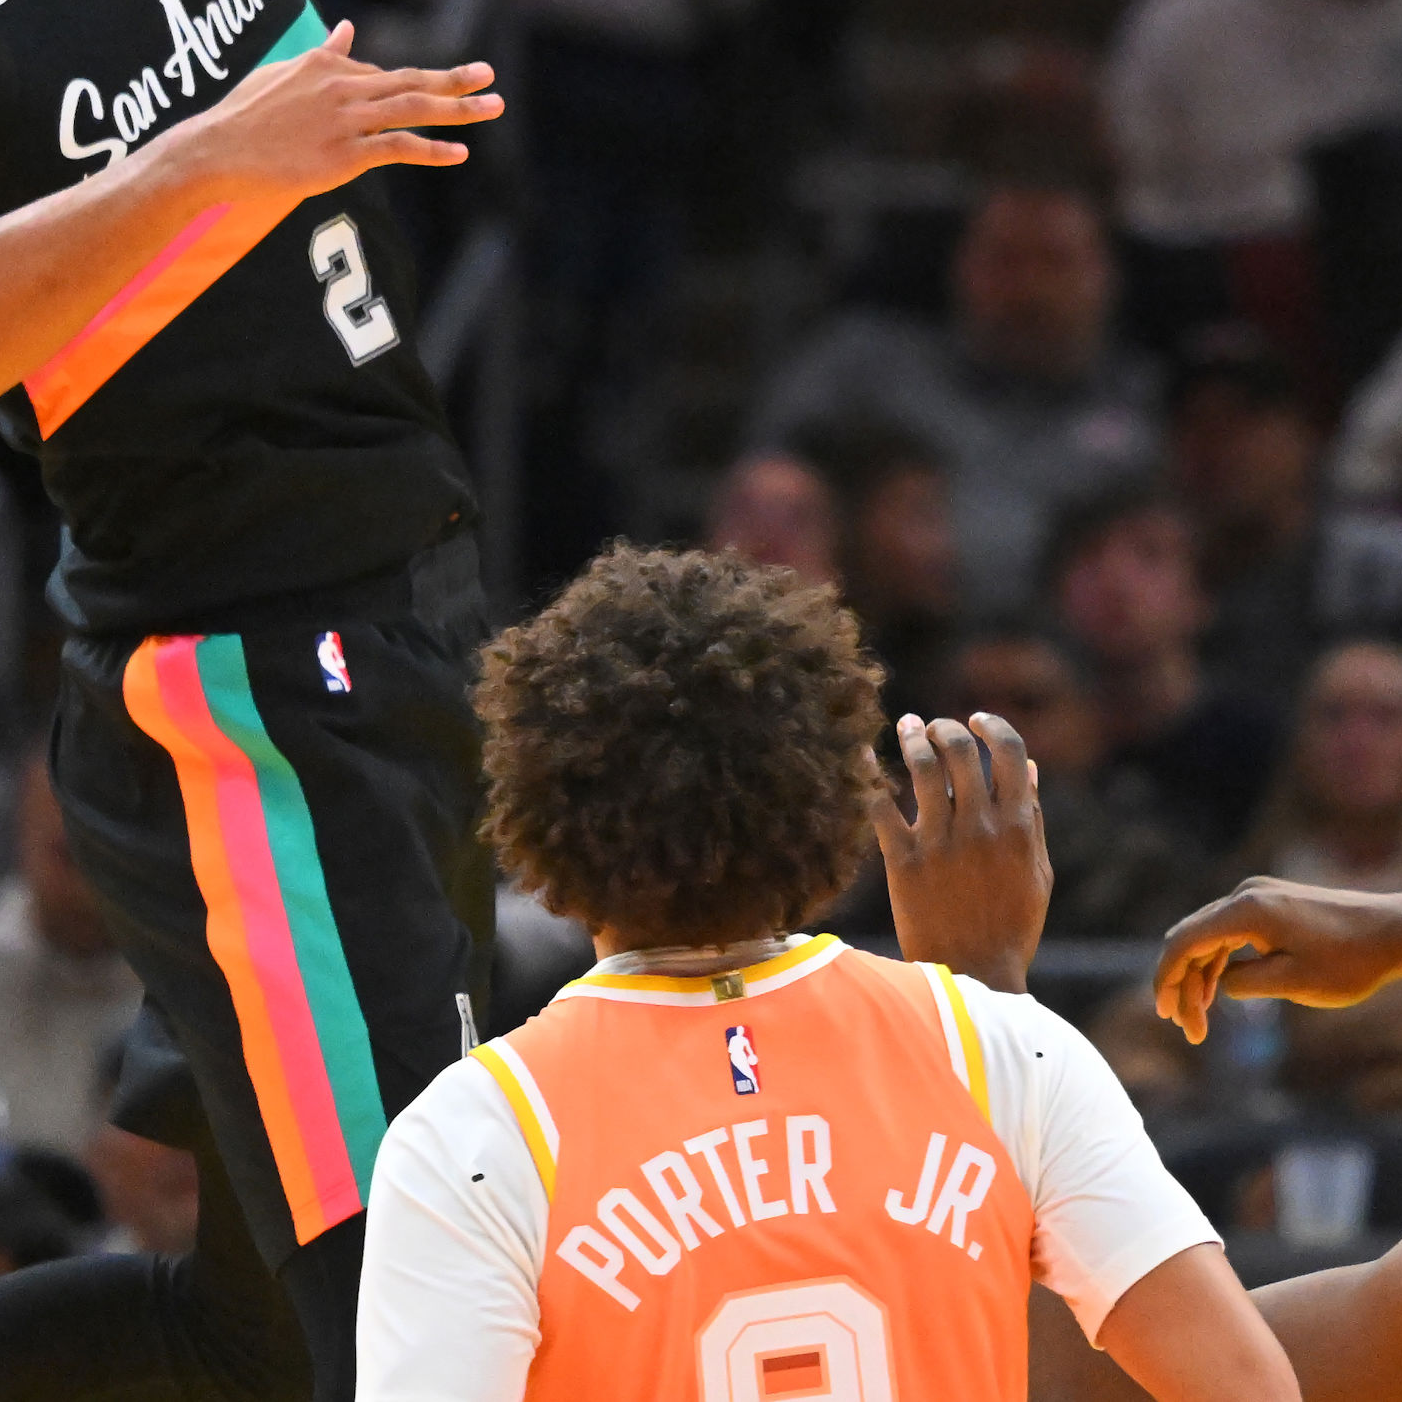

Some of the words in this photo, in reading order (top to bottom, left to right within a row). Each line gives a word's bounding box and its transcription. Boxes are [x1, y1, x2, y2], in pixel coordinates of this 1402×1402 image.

[59, 65, 172, 177] San
[308, 213, 400, 368] 2
[555, 1114, 837, 1313] PORTER
[884, 1131, 997, 1262] JR.
